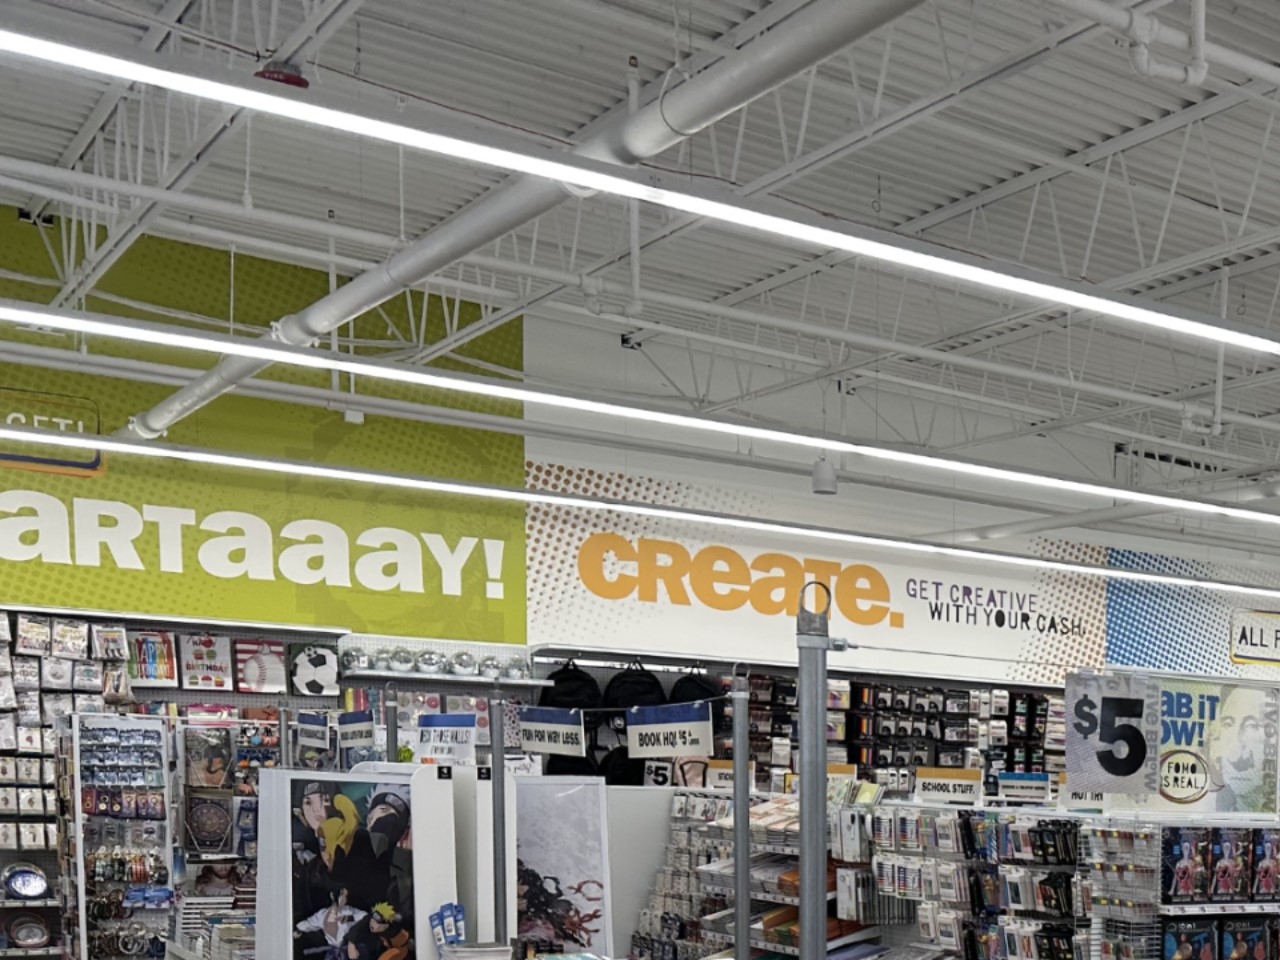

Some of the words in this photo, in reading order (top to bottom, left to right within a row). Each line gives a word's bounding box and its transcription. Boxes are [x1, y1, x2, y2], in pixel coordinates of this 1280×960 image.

[906, 579, 943, 600] GET
[950, 585, 1038, 613] CREATIVE
[929, 602, 977, 625] WITH
[984, 608, 1031, 631] YOUR
[1037, 614, 1086, 636] CASH.
[1239, 626, 1268, 647] ALL
[1161, 691, 1192, 718] aB
[522, 729, 534, 741] FUN
[534, 730, 546, 742] FOR
[639, 731, 661, 747] BOOK
[663, 731, 678, 748] HQ!
[1073, 694, 1147, 777] $5
[1161, 721, 1204, 747] OW!
[646, 766, 669, 786] $5
[1167, 762, 1197, 775] FOMO
[921, 782, 951, 795] SCHOOL
[953, 782, 975, 795] STUFF.
[1174, 776, 1204, 790] REAL.
